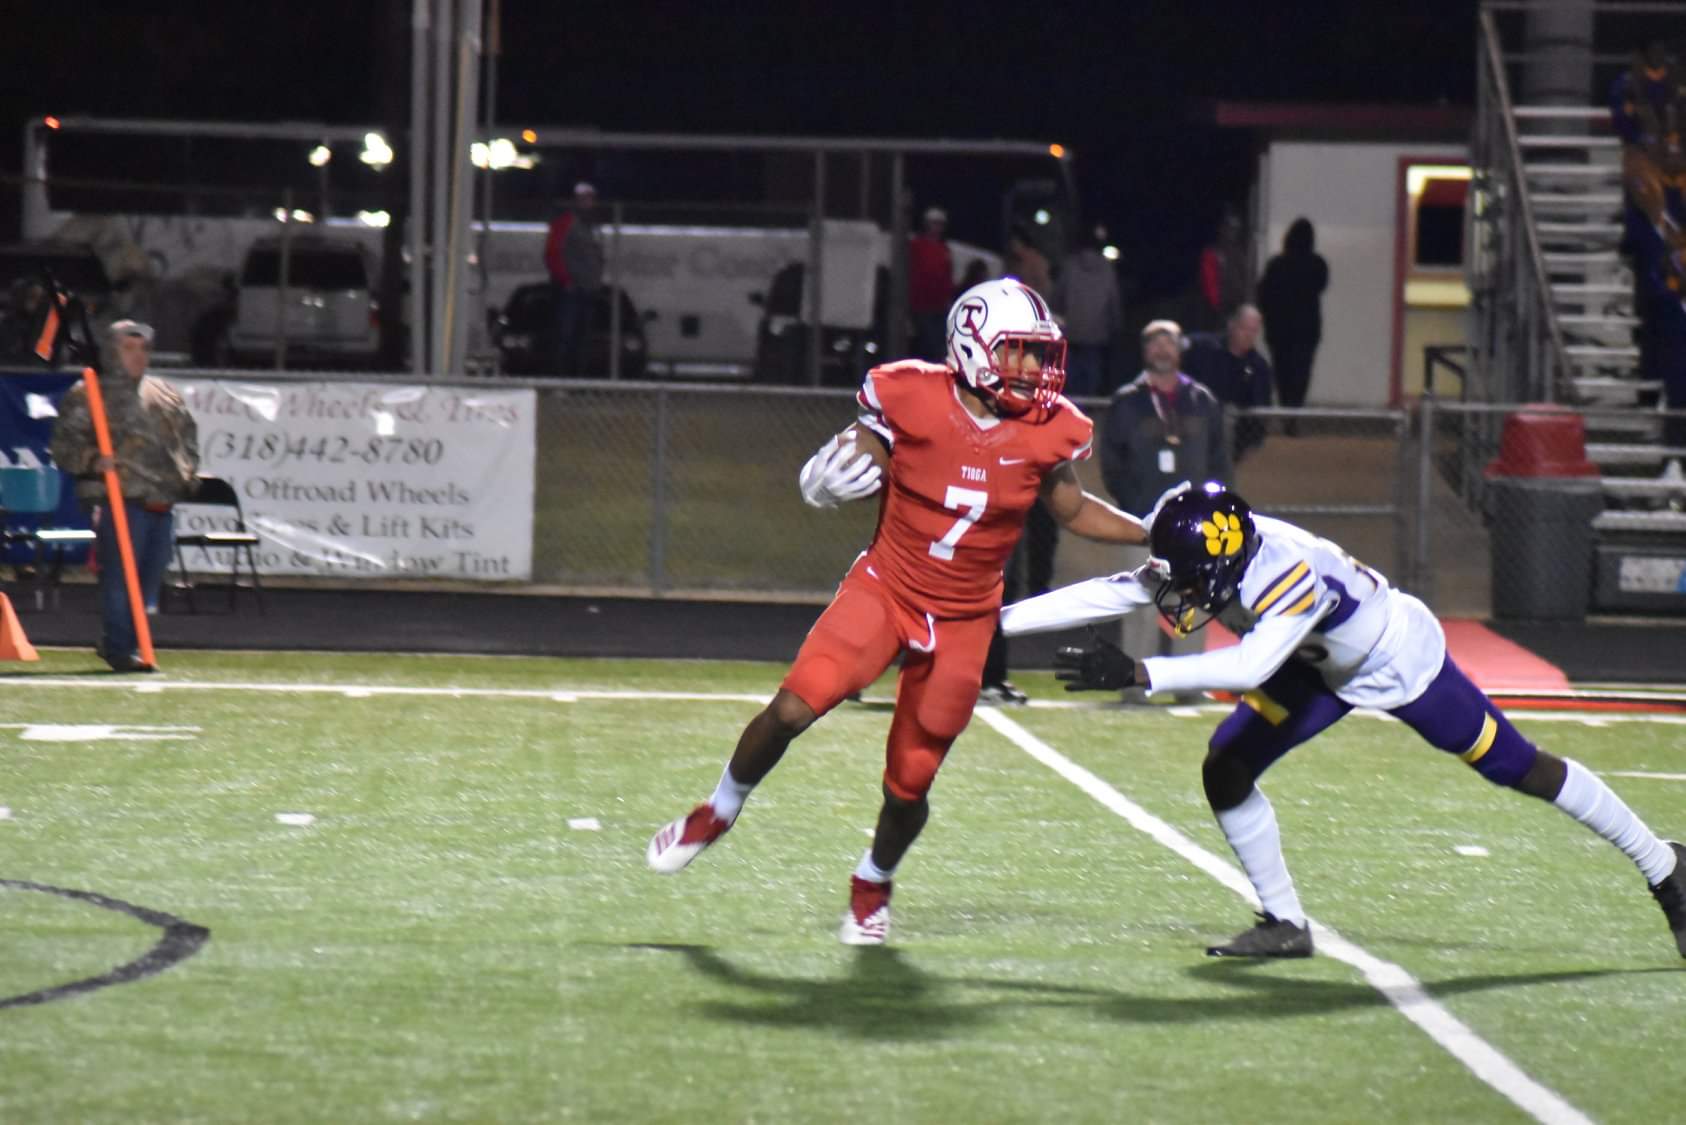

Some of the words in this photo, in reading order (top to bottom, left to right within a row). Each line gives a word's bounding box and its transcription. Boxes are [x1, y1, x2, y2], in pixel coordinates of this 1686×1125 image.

[203, 429, 445, 468] (318)442-8780
[244, 476, 356, 503] Offroad
[365, 479, 470, 505] Wheels
[326, 512, 352, 537] &
[361, 513, 409, 538] Lift
[418, 516, 475, 540] Kits
[928, 484, 989, 561] 7
[455, 550, 511, 574] Tint
